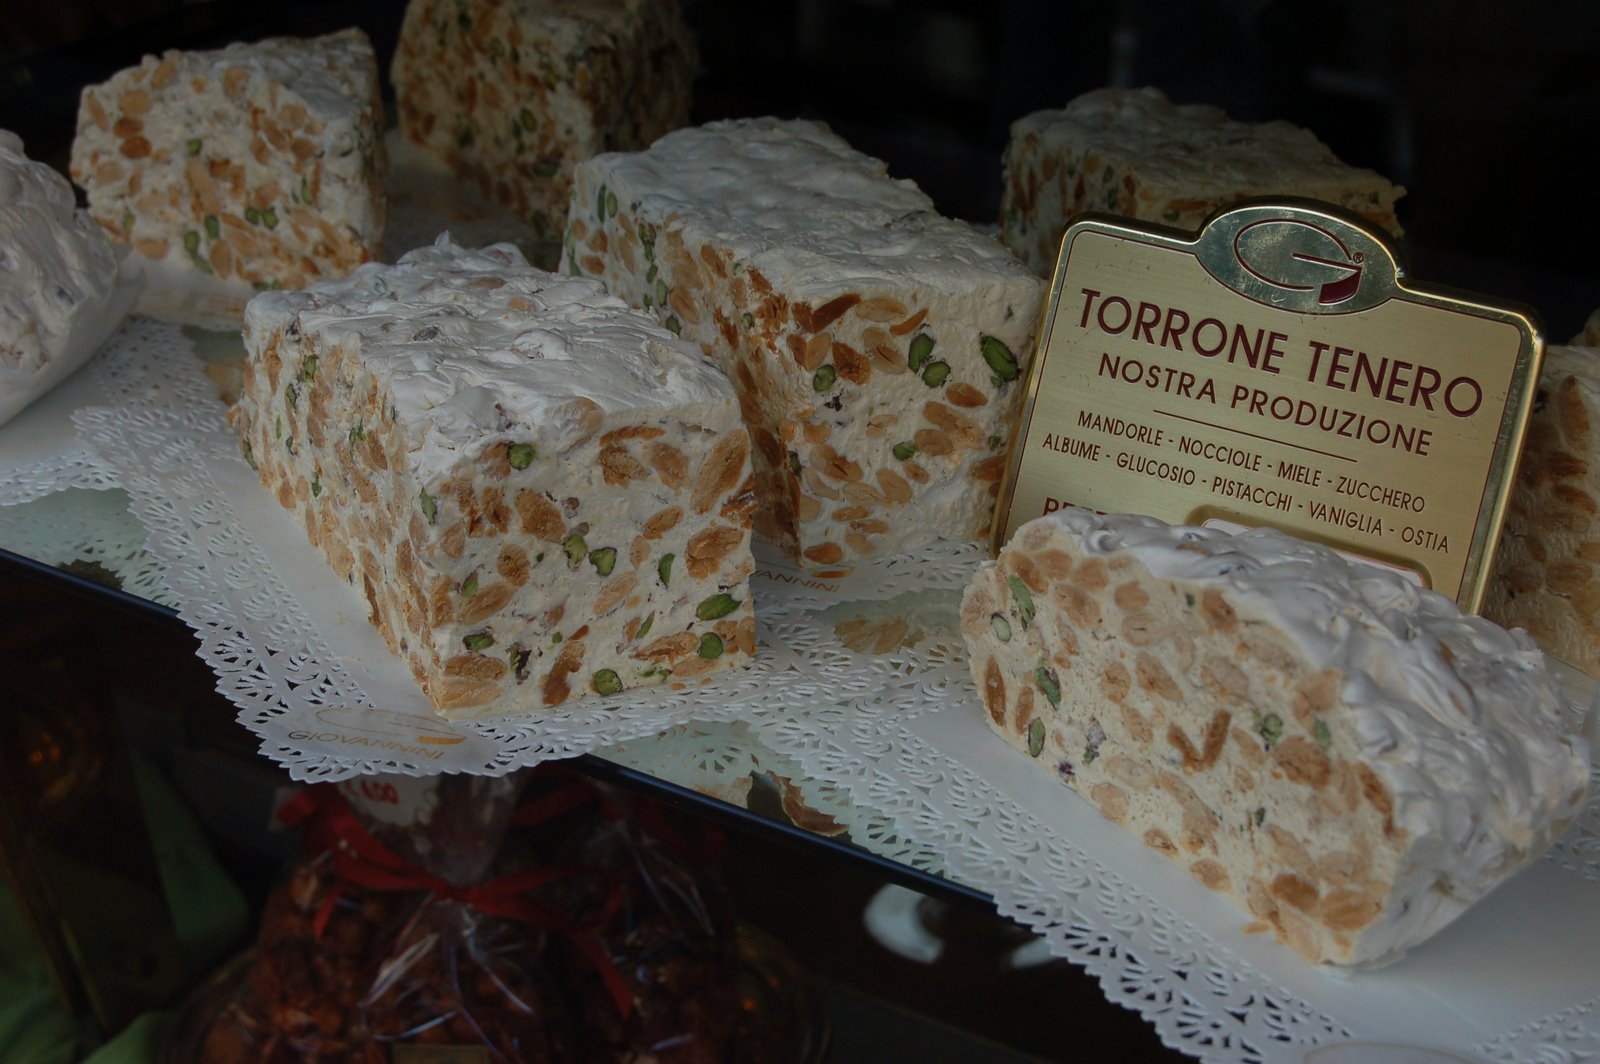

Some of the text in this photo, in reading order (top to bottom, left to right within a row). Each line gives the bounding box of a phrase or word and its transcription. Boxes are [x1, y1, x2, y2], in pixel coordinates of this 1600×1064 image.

[1080, 287, 1483, 417] TORRONE TENERO
[1098, 352, 1433, 457] NOSTRA PRODUZIONE
[1042, 433, 1101, 462] ALBUME
[1116, 452, 1196, 486] GLUCOSIO
[1212, 476, 1293, 512] PISTACCHI
[1309, 501, 1382, 536] VANIGLIA
[1401, 526, 1449, 553] OSTIA
[1077, 410, 1164, 447] MANDORLE
[1178, 436, 1262, 472] NOCCIOLE
[1277, 461, 1322, 487] MIELE
[1336, 476, 1426, 513] ZUCCHERO
[750, 569, 840, 593] ANNINI
[287, 729, 446, 760] GIOVANNINI
